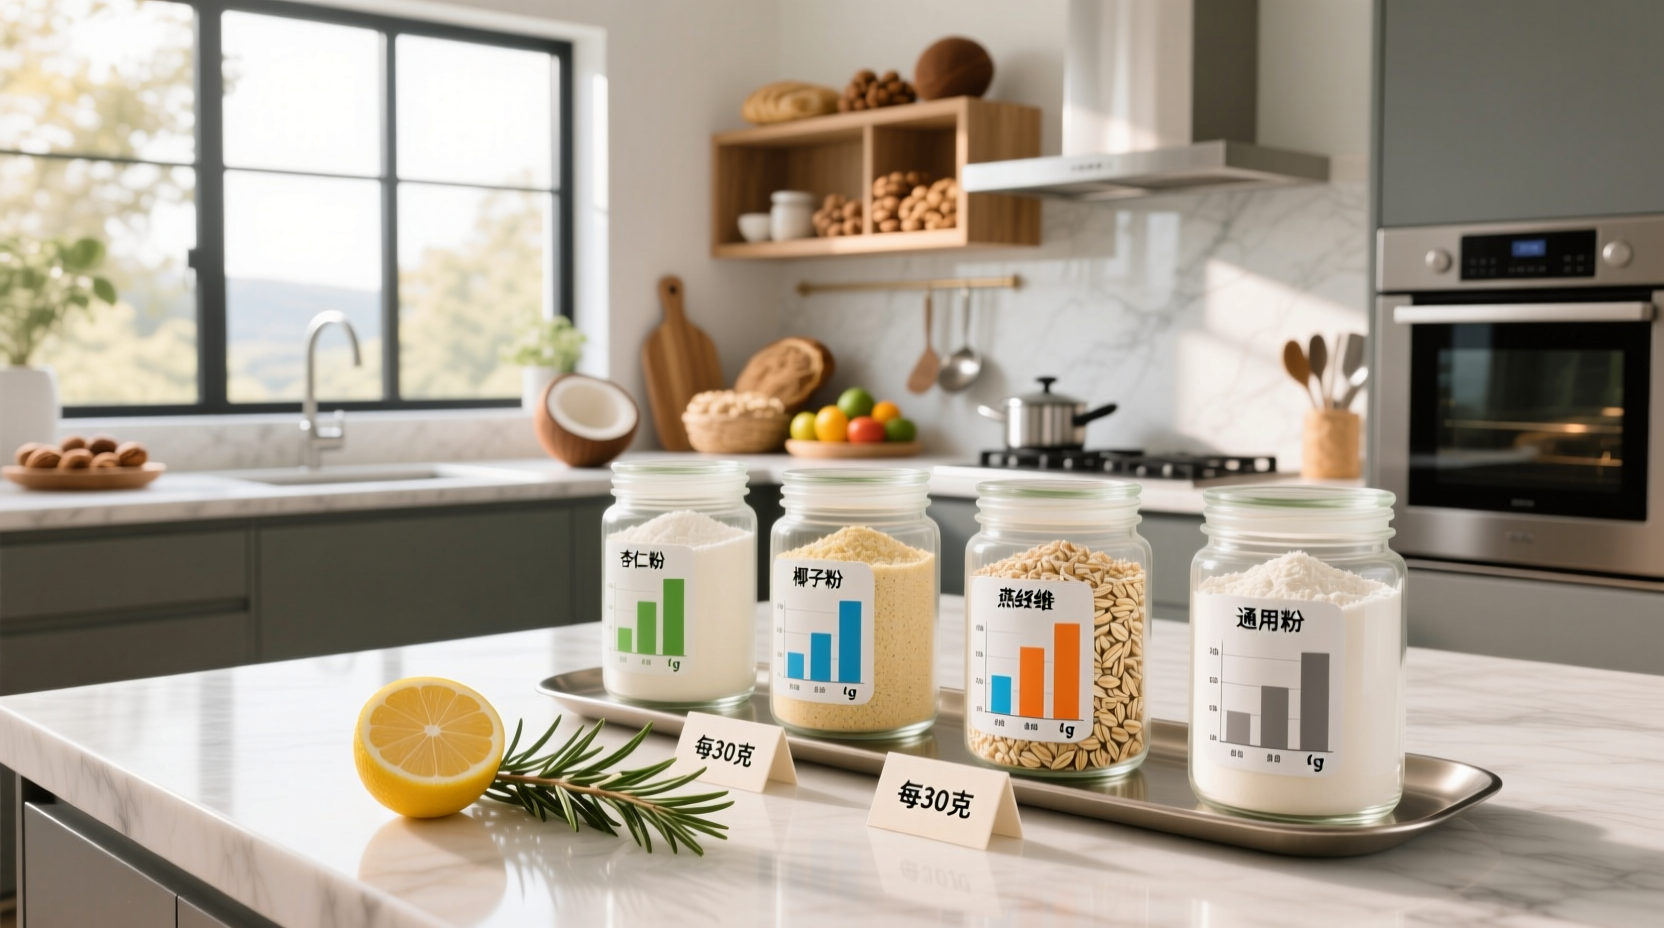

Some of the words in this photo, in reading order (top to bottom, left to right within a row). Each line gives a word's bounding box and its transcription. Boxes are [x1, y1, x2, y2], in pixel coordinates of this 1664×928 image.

[620, 549, 665, 570] 杏仁粉
[793, 566, 843, 589] 椰子粉
[1235, 607, 1305, 632] 通用粉
[695, 734, 755, 768] 每30克
[897, 779, 975, 819] 每30克
